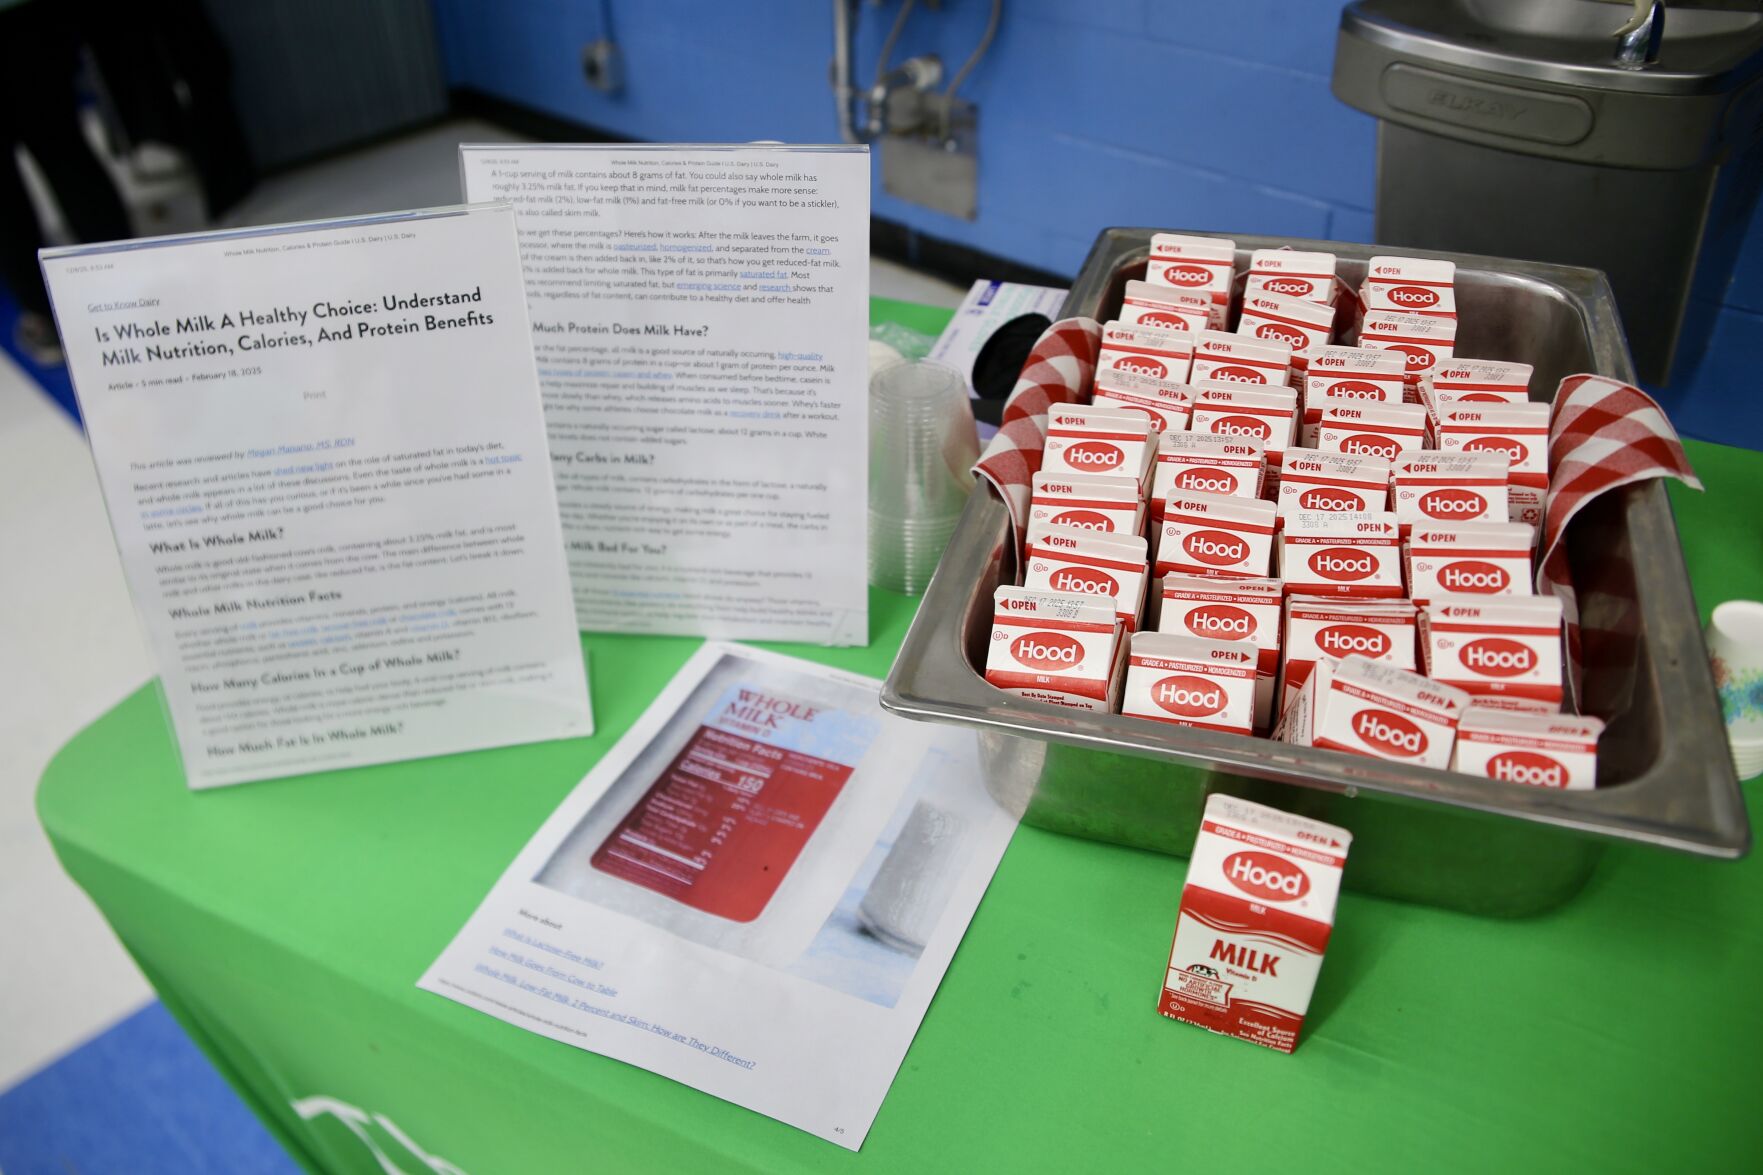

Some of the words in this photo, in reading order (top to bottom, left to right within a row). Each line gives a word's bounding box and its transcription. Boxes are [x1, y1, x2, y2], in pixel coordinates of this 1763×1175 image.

[499, 170, 518, 179] 1-cup
[520, 171, 546, 180] serving
[548, 170, 555, 178] of
[558, 170, 573, 178] milk
[575, 171, 607, 179] contains
[609, 171, 631, 179] about
[640, 172, 663, 180] grams
[665, 172, 673, 180] of
[675, 172, 687, 180] fat.
[689, 172, 703, 180] You
[705, 172, 726, 180] could
[728, 173, 743, 181] also
[745, 174, 758, 182] say
[760, 173, 783, 182] whole
[785, 173, 801, 182] milk
[804, 174, 817, 182] has
[789, 200, 799, 208] be
[1168, 270, 1209, 282] Hood
[1383, 267, 1401, 275] OPEN
[1268, 282, 1309, 293] Hood
[1393, 290, 1434, 303] Hood
[87, 303, 105, 313] Get
[105, 303, 112, 312] to
[114, 301, 138, 311] Know
[139, 297, 160, 308] Dairy
[1260, 301, 1279, 310] OPEN
[95, 327, 110, 343] Is
[114, 320, 170, 340] Whole
[176, 313, 215, 334] Milk
[220, 312, 235, 329] A
[240, 307, 307, 327] Healthy
[313, 300, 377, 319] Choice:
[383, 286, 482, 312] Understand
[533, 323, 564, 333] Much
[568, 323, 608, 334] Protein
[613, 323, 640, 335] Does
[644, 325, 669, 335] Milk
[674, 325, 708, 336] Have?
[1379, 323, 1397, 331] OPEN
[102, 350, 141, 367] Milk
[146, 342, 234, 362] Nutrition,
[238, 332, 312, 352] Calories,
[318, 324, 352, 343] And
[359, 317, 419, 338] Protein
[425, 311, 494, 331] Benefits
[1115, 332, 1134, 341] OPEN
[1261, 327, 1305, 347] Hood
[1212, 344, 1232, 352] OPEN
[1325, 358, 1345, 366] OPEN
[1120, 362, 1162, 379] Hood
[1450, 371, 1470, 379] OPEN
[108, 381, 133, 391] Article
[142, 379, 146, 387] 5
[148, 378, 164, 387] min
[166, 376, 183, 385] read
[192, 370, 226, 382] February
[241, 366, 262, 376] 2025
[303, 390, 326, 400] Print
[1158, 390, 1179, 399] OPEN
[1211, 392, 1232, 401] OPEN
[1333, 387, 1380, 400] Hood
[1339, 409, 1362, 419] OPEN
[1458, 412, 1482, 421] OPEN
[1064, 417, 1085, 426] OPEN
[1218, 422, 1265, 438] Hood
[1223, 446, 1246, 454] OPEN
[1347, 440, 1396, 459] Hood
[576, 452, 606, 463] Carbs
[611, 454, 620, 463] in
[624, 454, 654, 464] Milk?
[1070, 448, 1118, 465] Hood
[1299, 462, 1322, 472] OPEN
[1413, 464, 1437, 473] OPEN
[1050, 485, 1072, 494] OPEN
[1181, 475, 1231, 491] Hood
[1184, 502, 1208, 512] OPEN
[1306, 494, 1358, 512] Hood
[1426, 496, 1479, 513] Hood
[1057, 517, 1107, 533] Hood
[1357, 523, 1381, 532] OPEN
[150, 542, 185, 554] What
[189, 539, 199, 550] Is
[203, 534, 244, 548] Whole
[249, 527, 284, 541] Milk?
[1052, 537, 1077, 548] OPEN
[1430, 534, 1456, 543] OPEN
[1190, 536, 1243, 559] Hood
[1317, 555, 1371, 572] Hood
[1445, 569, 1503, 588] Hood
[1056, 574, 1112, 597] Hood
[169, 609, 210, 620] Whole
[214, 602, 242, 614] Milk
[247, 593, 305, 609] Nutrition
[309, 590, 342, 601] Facts
[1012, 601, 1037, 611] OPEN
[1453, 607, 1481, 617] OPEN
[1193, 612, 1249, 633] Hood
[1323, 631, 1383, 652] Hood
[1018, 640, 1077, 662] Hood
[1211, 650, 1238, 660] OPEN
[1467, 649, 1530, 669] Hood
[1142, 659, 1158, 667] GRADE
[1169, 663, 1203, 672] PASTEURIZED
[1208, 668, 1246, 677] HOMOGENIZED
[1037, 675, 1050, 683] MILK
[1160, 683, 1220, 708] Hood
[1417, 690, 1445, 705] OPEN
[738, 689, 820, 723] WHOLE
[724, 703, 785, 728] MILK
[1359, 714, 1421, 753] Hood
[1494, 761, 1561, 788] Hood
[1296, 830, 1328, 845] OPEN
[1232, 857, 1303, 896] Hood
[1250, 903, 1266, 915] MILK
[1209, 938, 1281, 977] MILK
[1226, 968, 1250, 980] Vitamin
[475, 963, 500, 977] Whole
[580, 1002, 610, 1016] Percent
[610, 1012, 627, 1022] and
[651, 1024, 672, 1038] How
[672, 1034, 686, 1044] are
[689, 1037, 710, 1052] They
[711, 1046, 756, 1070] Different?
[1238, 1018, 1270, 1031] Excellent
[1272, 1026, 1296, 1036] Source
[1266, 1033, 1294, 1043] Calcium
